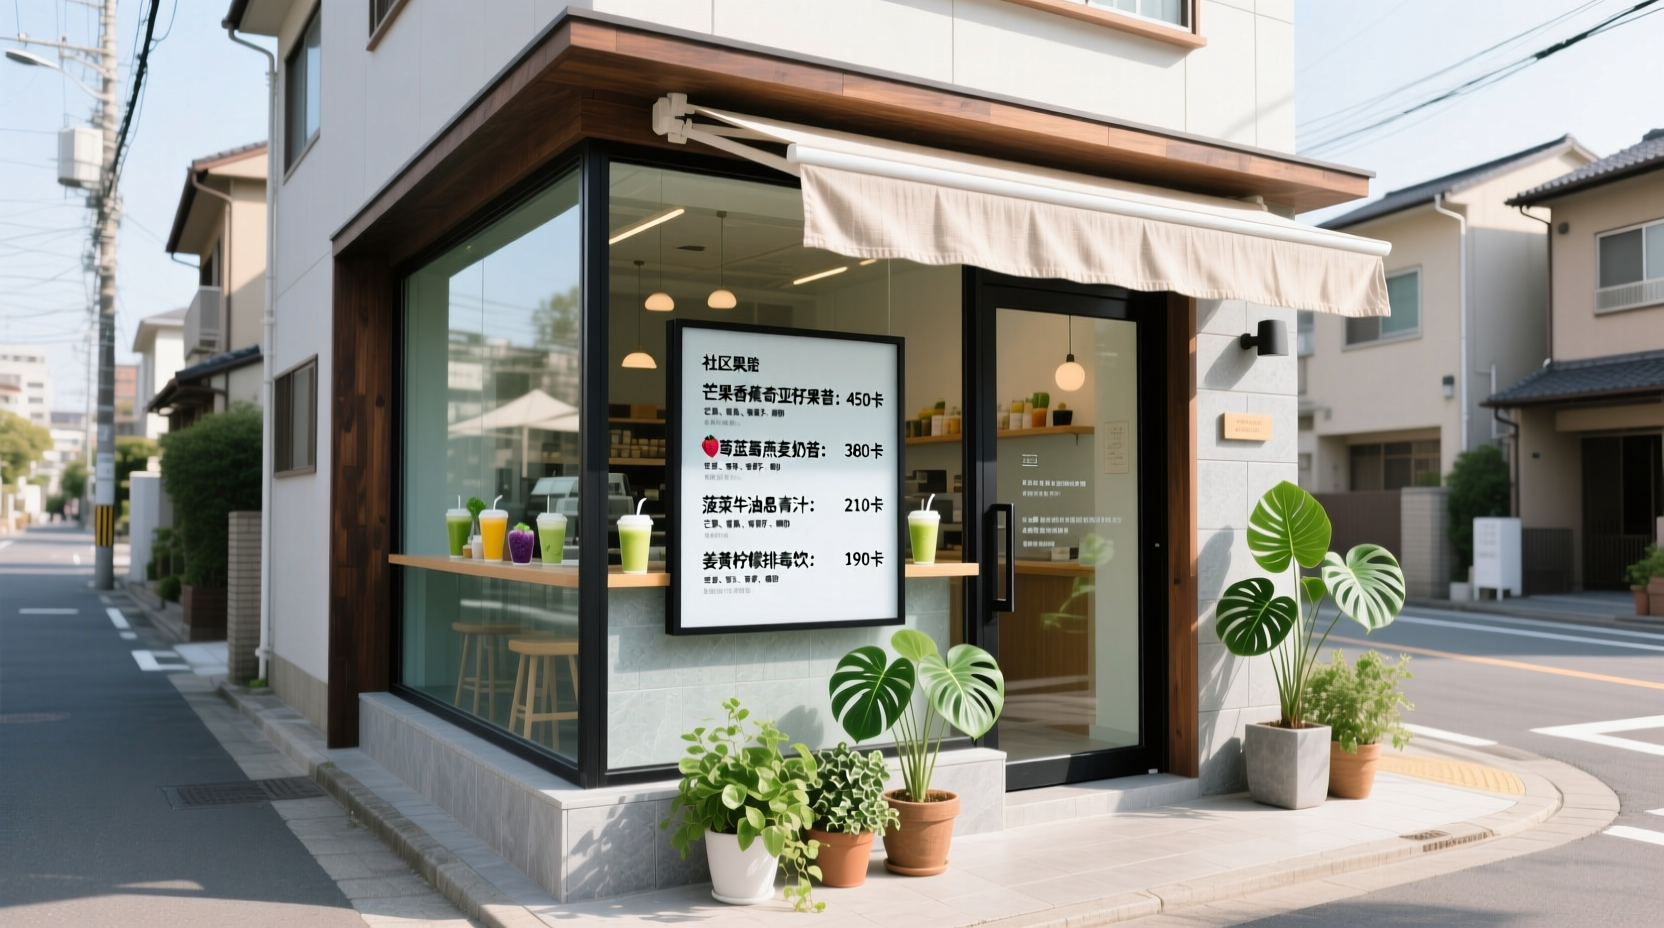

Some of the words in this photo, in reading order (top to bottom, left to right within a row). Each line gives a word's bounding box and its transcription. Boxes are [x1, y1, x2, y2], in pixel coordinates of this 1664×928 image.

[845, 390, 885, 409] 450卡
[844, 442, 884, 460] 380卡
[844, 495, 884, 513] 210卡
[844, 550, 885, 568] 190卡
